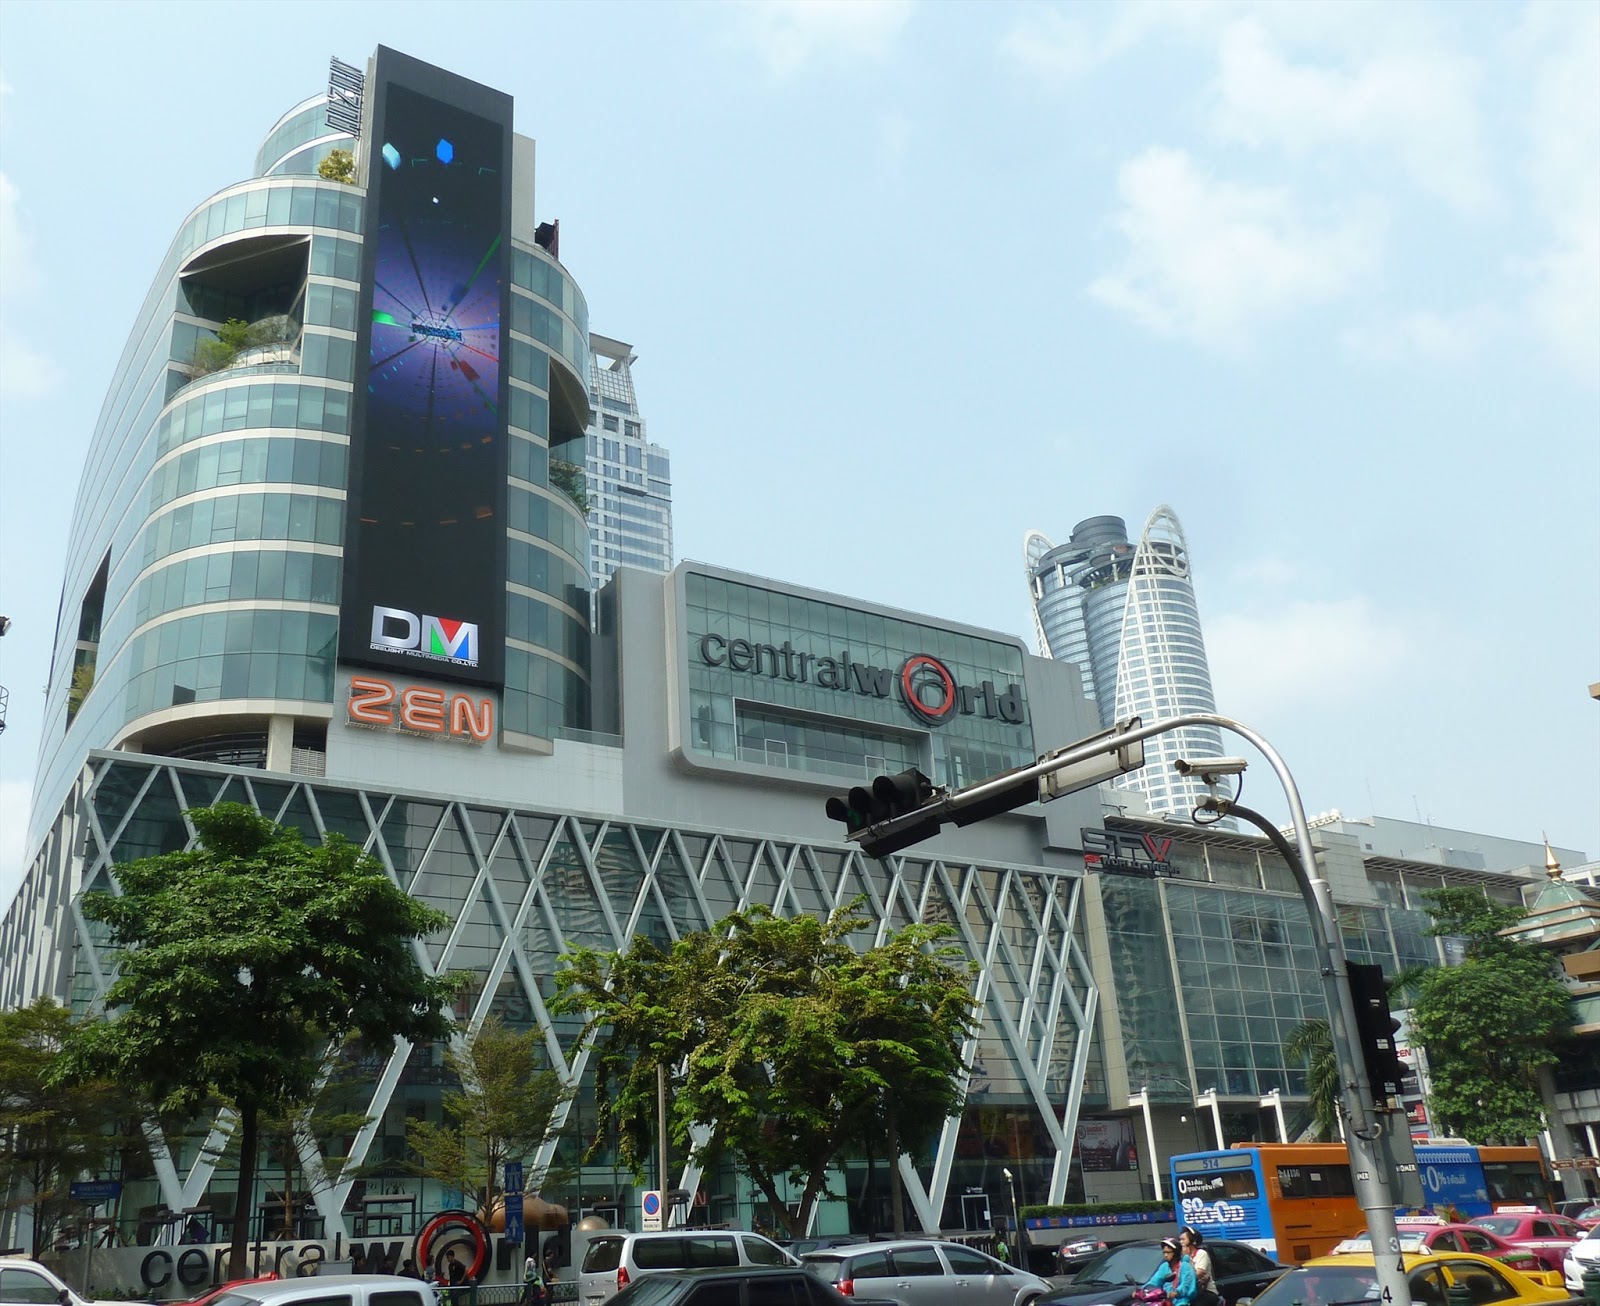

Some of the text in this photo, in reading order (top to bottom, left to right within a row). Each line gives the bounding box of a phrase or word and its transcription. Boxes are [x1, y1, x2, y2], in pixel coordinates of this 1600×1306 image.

[371, 605, 479, 661] DM
[406, 651, 450, 663] MULTIMEDIA
[349, 676, 493, 740] ZEN
[1203, 1159, 1219, 1169] 514
[1181, 1197, 1204, 1213] SO
[1389, 1237, 1399, 1252] 3
[1382, 1285, 1393, 1304] 4
